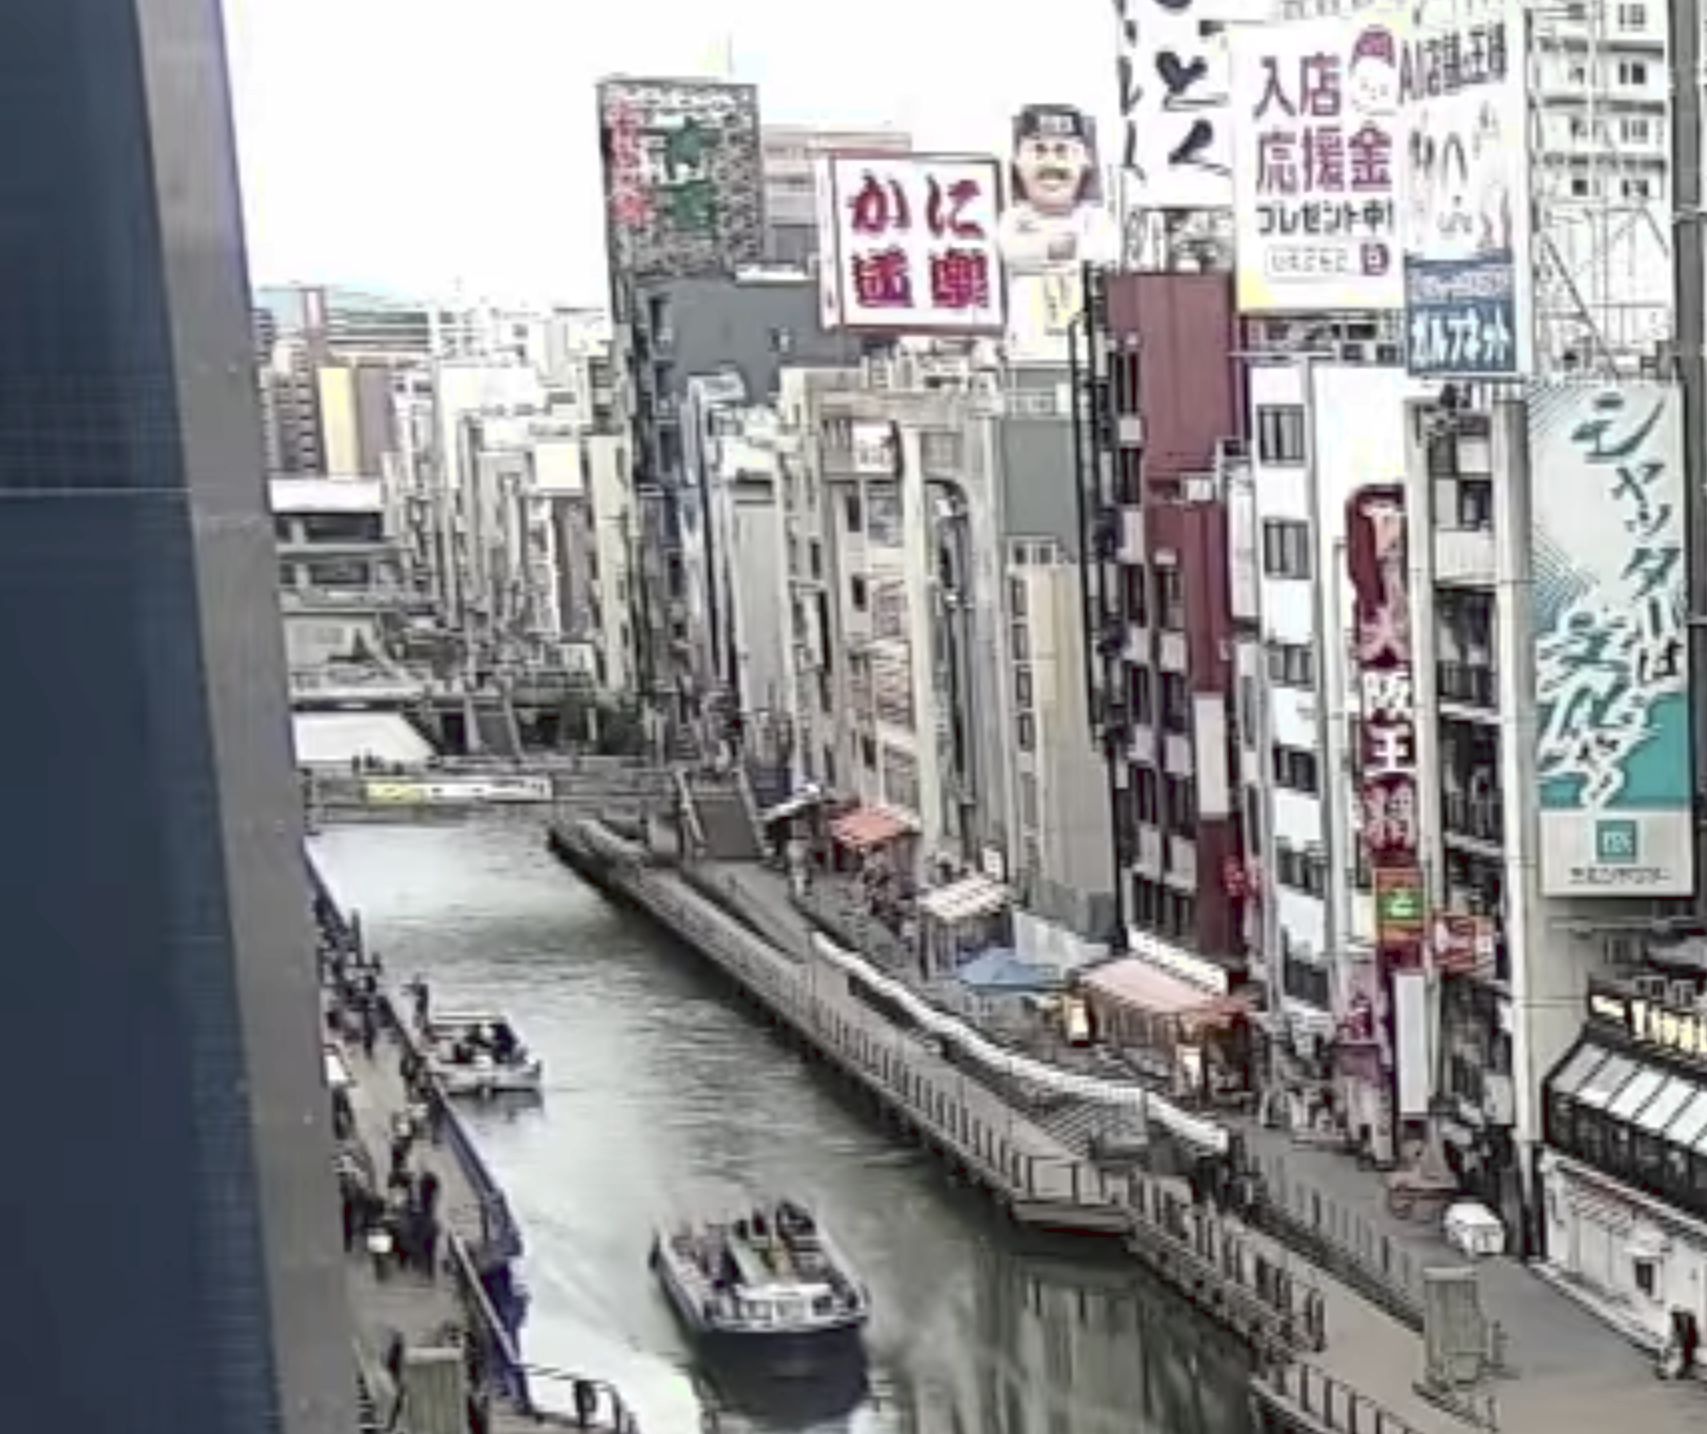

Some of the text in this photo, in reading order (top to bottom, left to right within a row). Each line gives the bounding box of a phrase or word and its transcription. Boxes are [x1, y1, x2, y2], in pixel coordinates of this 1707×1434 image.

[1252, 52, 1342, 120] 入店
[1255, 120, 1393, 195] 応援金
[847, 167, 986, 239] かに
